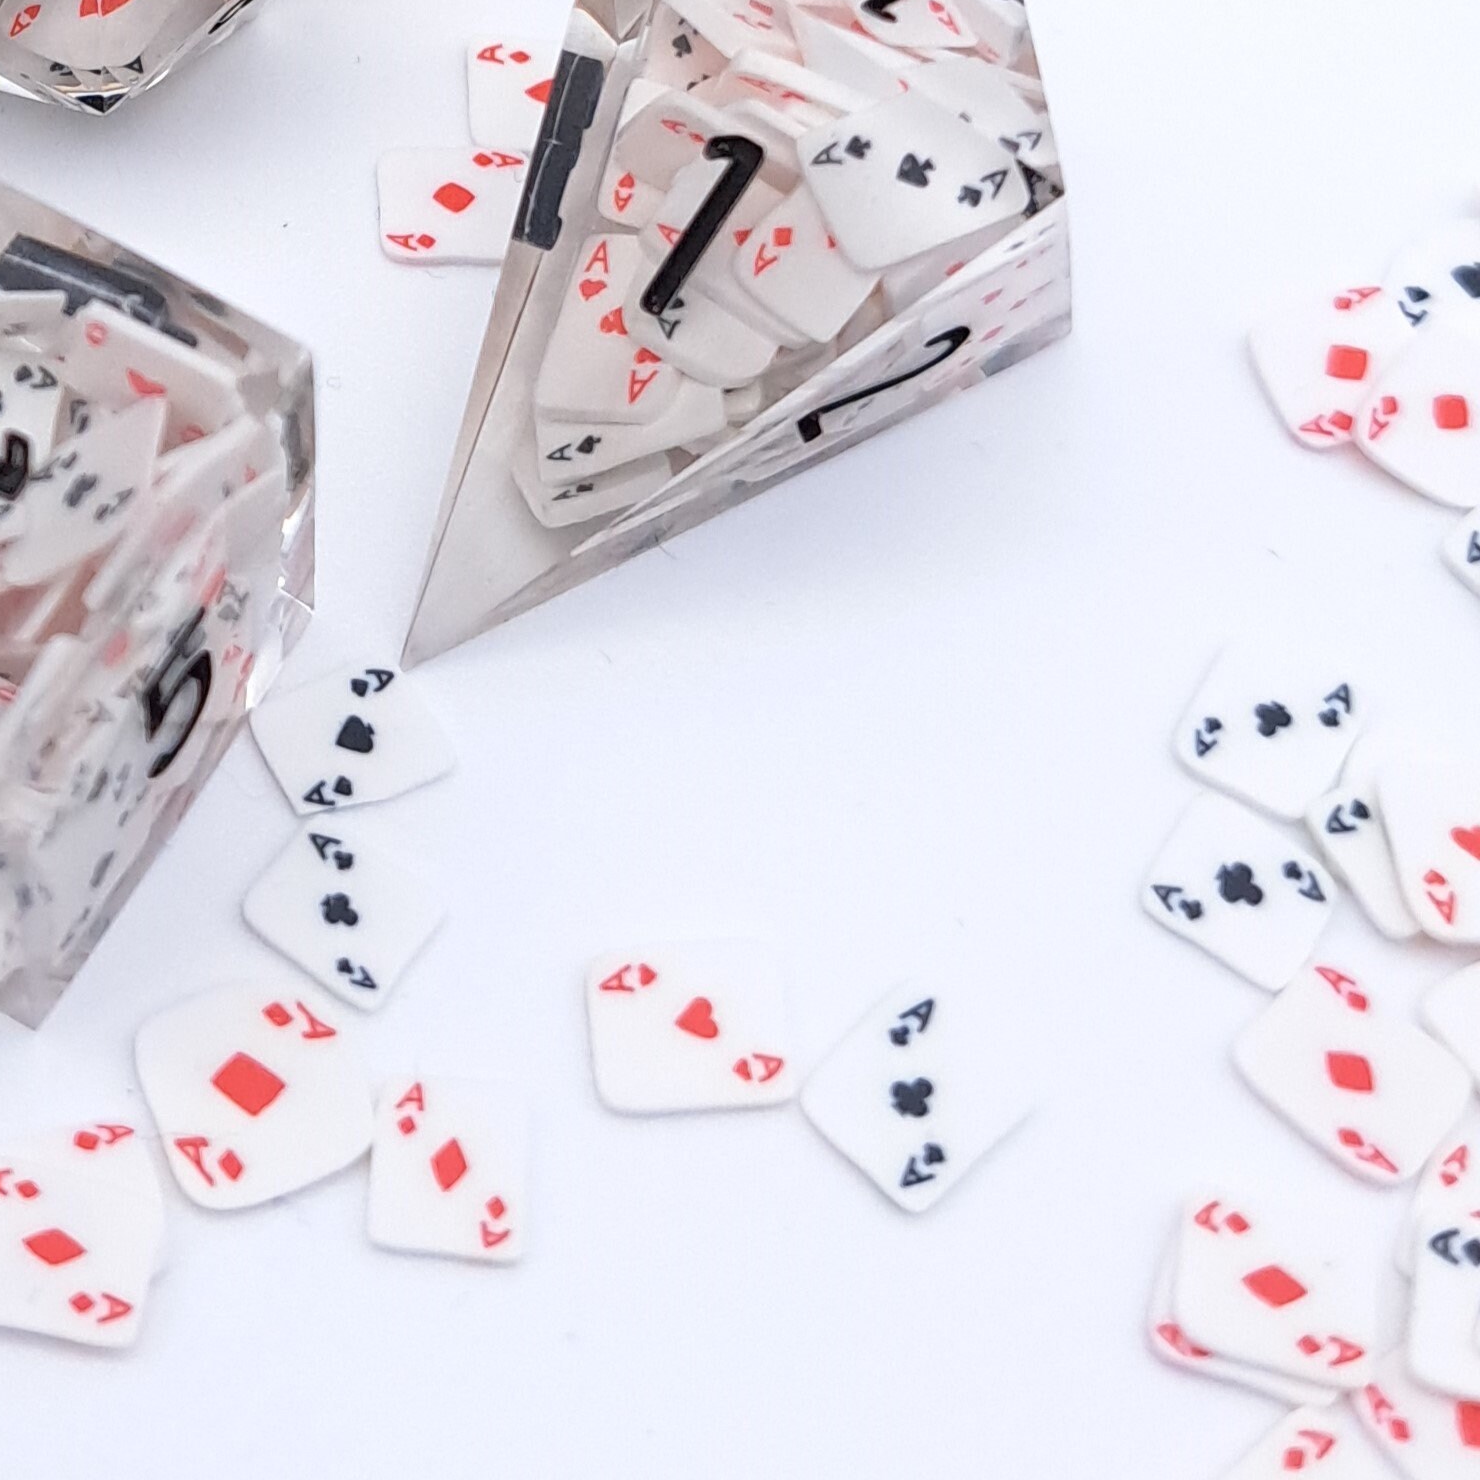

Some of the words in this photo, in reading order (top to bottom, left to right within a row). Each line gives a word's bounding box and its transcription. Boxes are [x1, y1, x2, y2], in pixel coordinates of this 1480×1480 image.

[9, 12, 31, 38] A
[477, 44, 504, 65] A
[492, 152, 524, 167] A
[811, 142, 844, 165] A
[979, 168, 1009, 200] A
[614, 190, 633, 213] A
[639, 134, 764, 317] 1
[386, 233, 418, 251] A
[584, 241, 609, 274] A
[753, 243, 778, 277] A
[1347, 286, 1382, 303] A
[29, 365, 58, 388] A
[628, 369, 659, 404] A
[797, 325, 971, 443] 2
[1299, 414, 1335, 437] A
[1369, 407, 1390, 440] A
[547, 442, 572, 462] A
[142, 606, 213, 779] 5
[365, 669, 394, 692] A
[1324, 683, 1352, 714] A
[1195, 728, 1218, 757] A
[302, 780, 335, 806] A
[1325, 804, 1358, 833] A
[308, 833, 342, 862] A
[1153, 884, 1183, 912] A
[1299, 870, 1326, 902] A
[1426, 891, 1455, 925] A
[349, 966, 377, 989] A
[599, 964, 635, 992] A
[1314, 965, 1356, 994] A
[296, 1001, 336, 1039] A
[898, 998, 935, 1033] A
[752, 1053, 784, 1082] A
[395, 1082, 424, 1112] A
[96, 1124, 135, 1145] A
[174, 1137, 215, 1187] A
[900, 1157, 936, 1188] A
[1356, 1143, 1399, 1173] A
[1442, 1145, 1469, 1172] A
[1194, 1200, 1221, 1233] A
[481, 1221, 510, 1247] A
[1428, 1227, 1460, 1266] A
[97, 1292, 133, 1323] A
[1328, 1336, 1365, 1367] A
[1298, 1429, 1335, 1460] A
